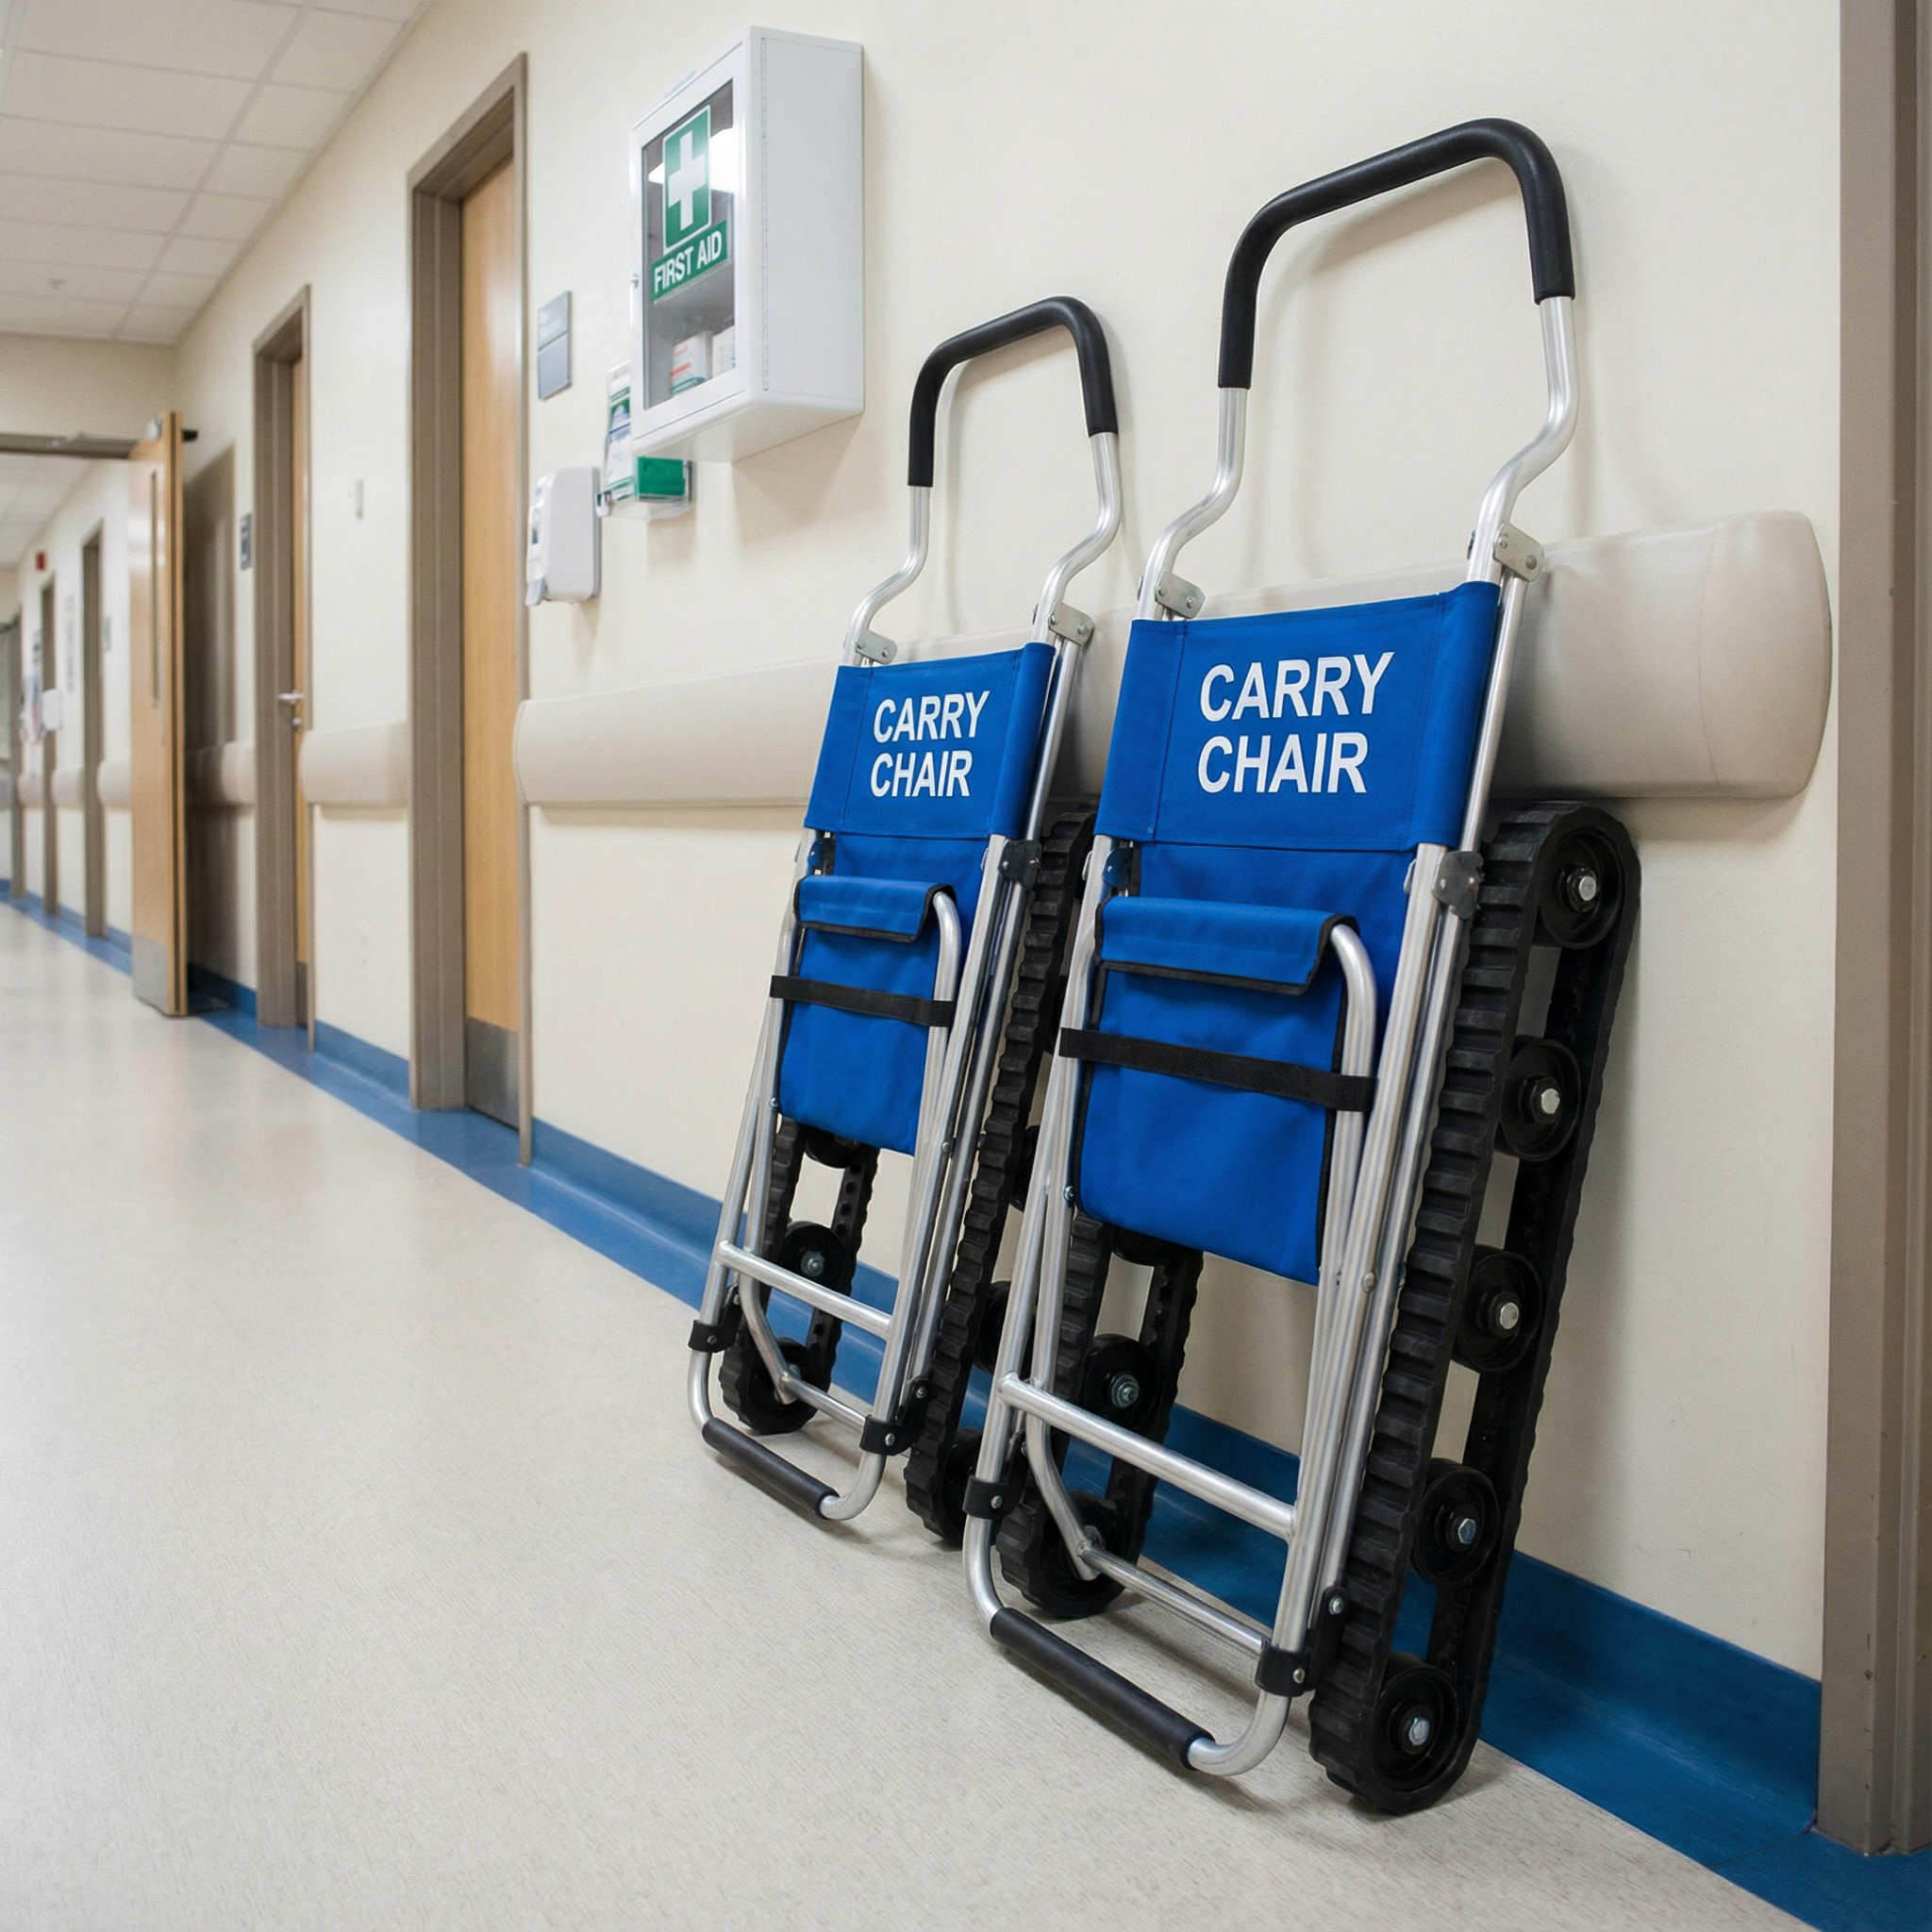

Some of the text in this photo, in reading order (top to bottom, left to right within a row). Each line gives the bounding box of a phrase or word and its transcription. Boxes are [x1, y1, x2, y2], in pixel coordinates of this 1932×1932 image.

[654, 230, 723, 294] FIRST AID
[874, 690, 990, 743] CARRY
[1201, 651, 1394, 723] CARRY
[871, 751, 973, 798] CHAIR
[1198, 732, 1369, 793] CHAIR
